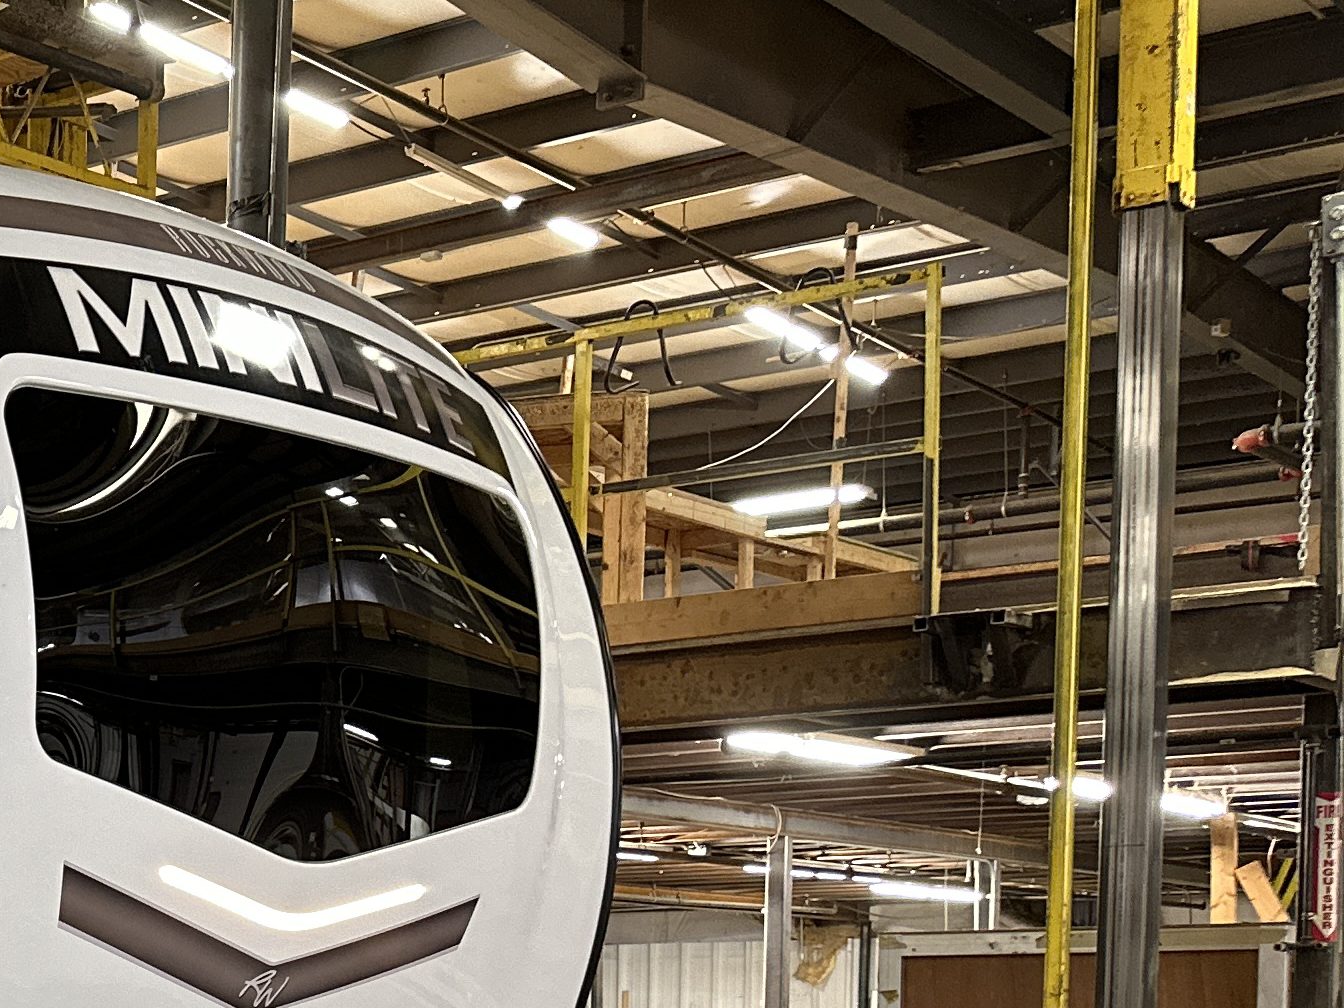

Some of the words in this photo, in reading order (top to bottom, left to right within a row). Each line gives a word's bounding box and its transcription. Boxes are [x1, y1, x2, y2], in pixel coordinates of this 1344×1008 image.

[162, 222, 317, 293] ROCKWOOD
[46, 266, 477, 458] MINILITE
[1322, 823, 1334, 930] EXTINGUISHER
